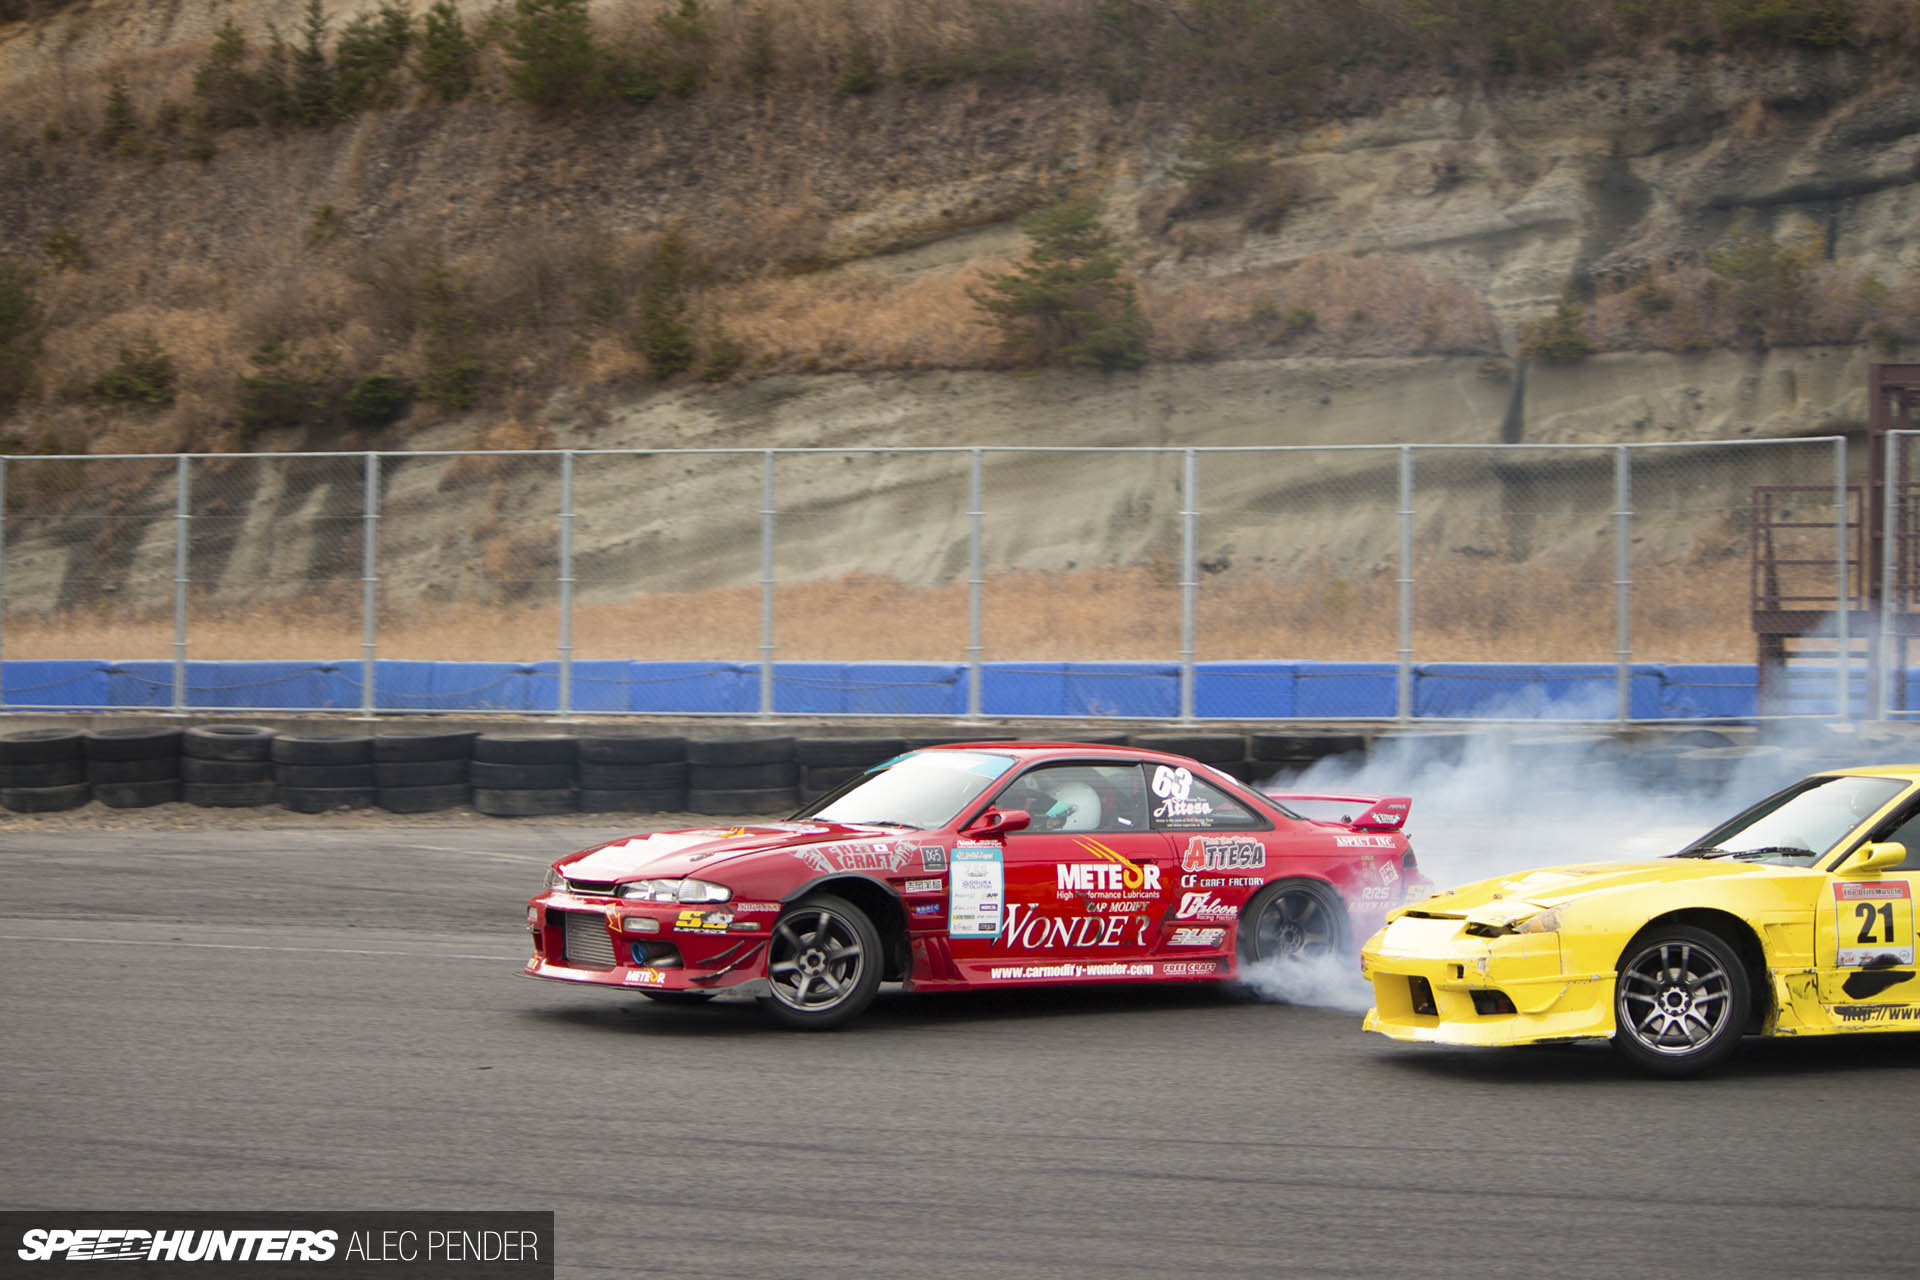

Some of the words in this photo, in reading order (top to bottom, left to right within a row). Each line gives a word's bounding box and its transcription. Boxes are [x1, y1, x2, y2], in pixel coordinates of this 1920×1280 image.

[1152, 765, 1193, 800] 63
[842, 854, 891, 869] CRAFT
[1183, 837, 1265, 871] ATTESA
[1057, 863, 1162, 890] METEOR
[1181, 874, 1197, 888] CF
[1200, 878, 1225, 888] CRAFT
[1229, 877, 1264, 887] FACTORY
[1057, 891, 1073, 901] High
[1075, 890, 1121, 899] formance
[1123, 890, 1160, 898] Lubricants
[1109, 902, 1150, 912] MODIFY
[1855, 902, 1894, 944] 21
[625, 968, 666, 984] METEOR
[991, 963, 1154, 979] www.carmodify-wonder.com
